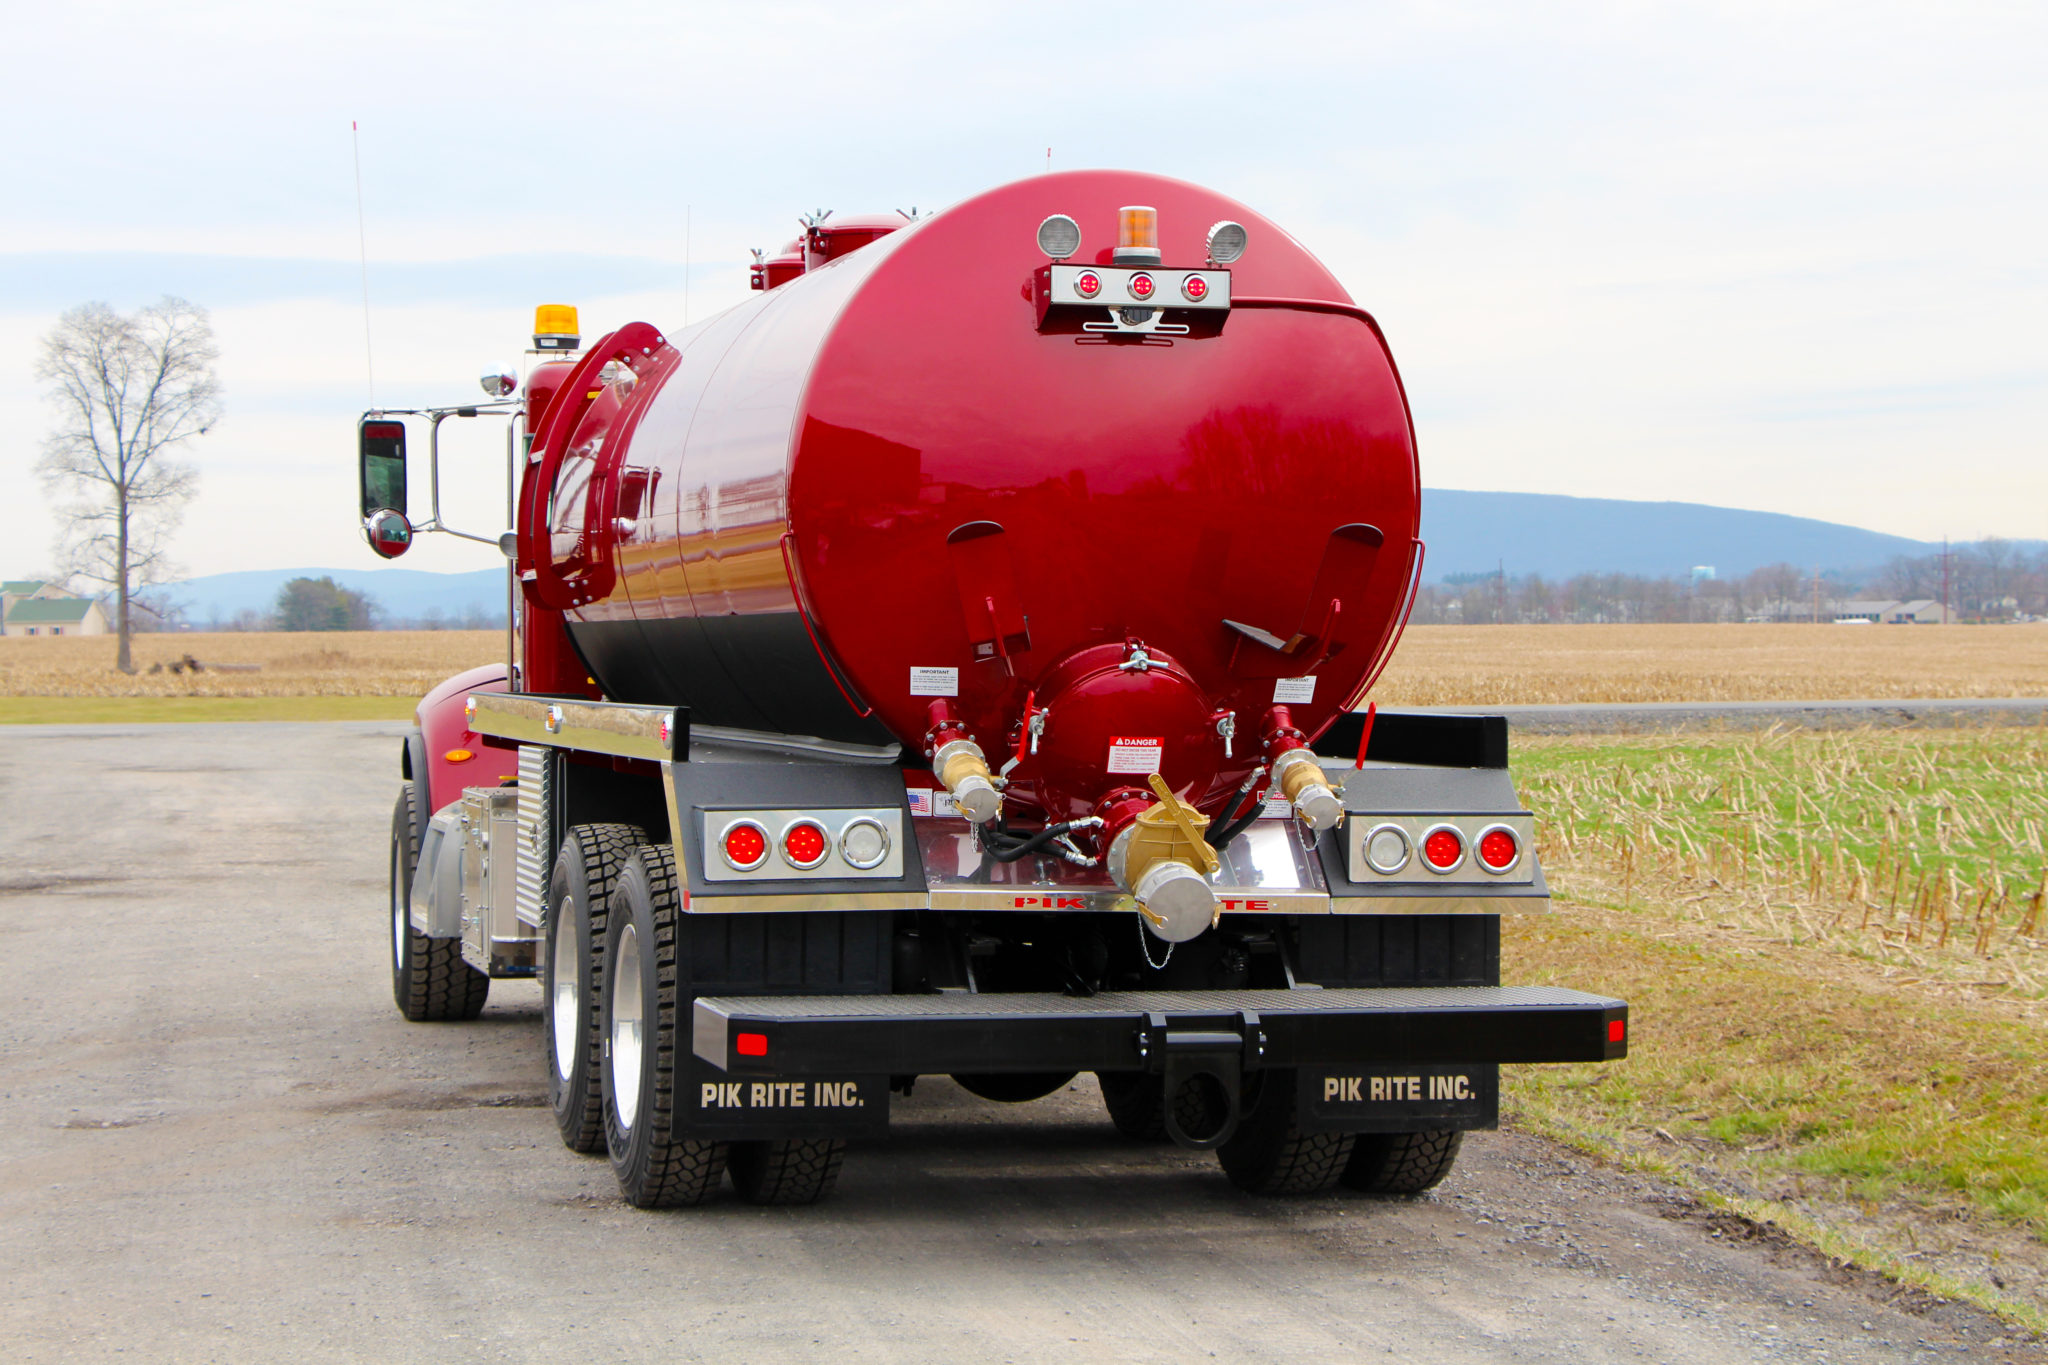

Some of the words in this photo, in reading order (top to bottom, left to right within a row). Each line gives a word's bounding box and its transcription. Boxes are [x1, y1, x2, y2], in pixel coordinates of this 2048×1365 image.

[1014, 897, 1087, 909] PIK
[1221, 900, 1269, 910] TE
[701, 1083, 742, 1108] PIK
[751, 1082, 805, 1108] RITE
[814, 1081, 864, 1107] INC.
[1324, 1077, 1362, 1102] PIK
[1370, 1076, 1421, 1101] RITE
[1429, 1075, 1476, 1100] INC.
